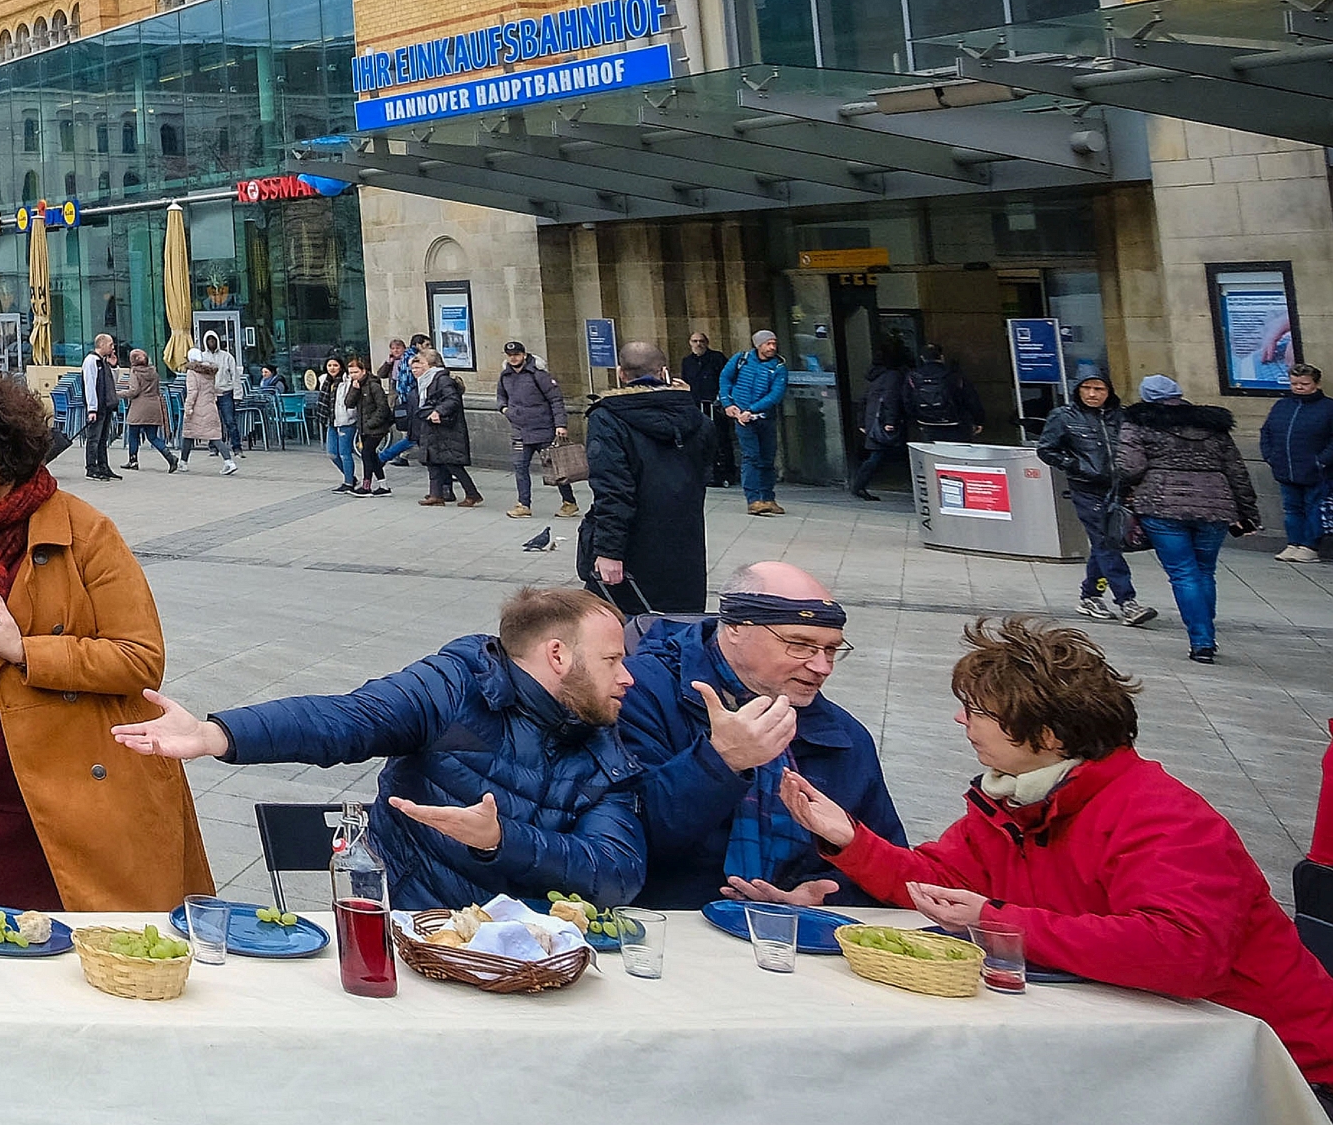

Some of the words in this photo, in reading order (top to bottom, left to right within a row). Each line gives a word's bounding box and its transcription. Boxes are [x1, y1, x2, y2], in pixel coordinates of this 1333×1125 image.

[351, 51, 393, 93] IHR
[384, 88, 470, 121] HANNOVER
[476, 59, 625, 106] HAUPTBAHNHOF
[237, 175, 320, 202] ROSSMA
